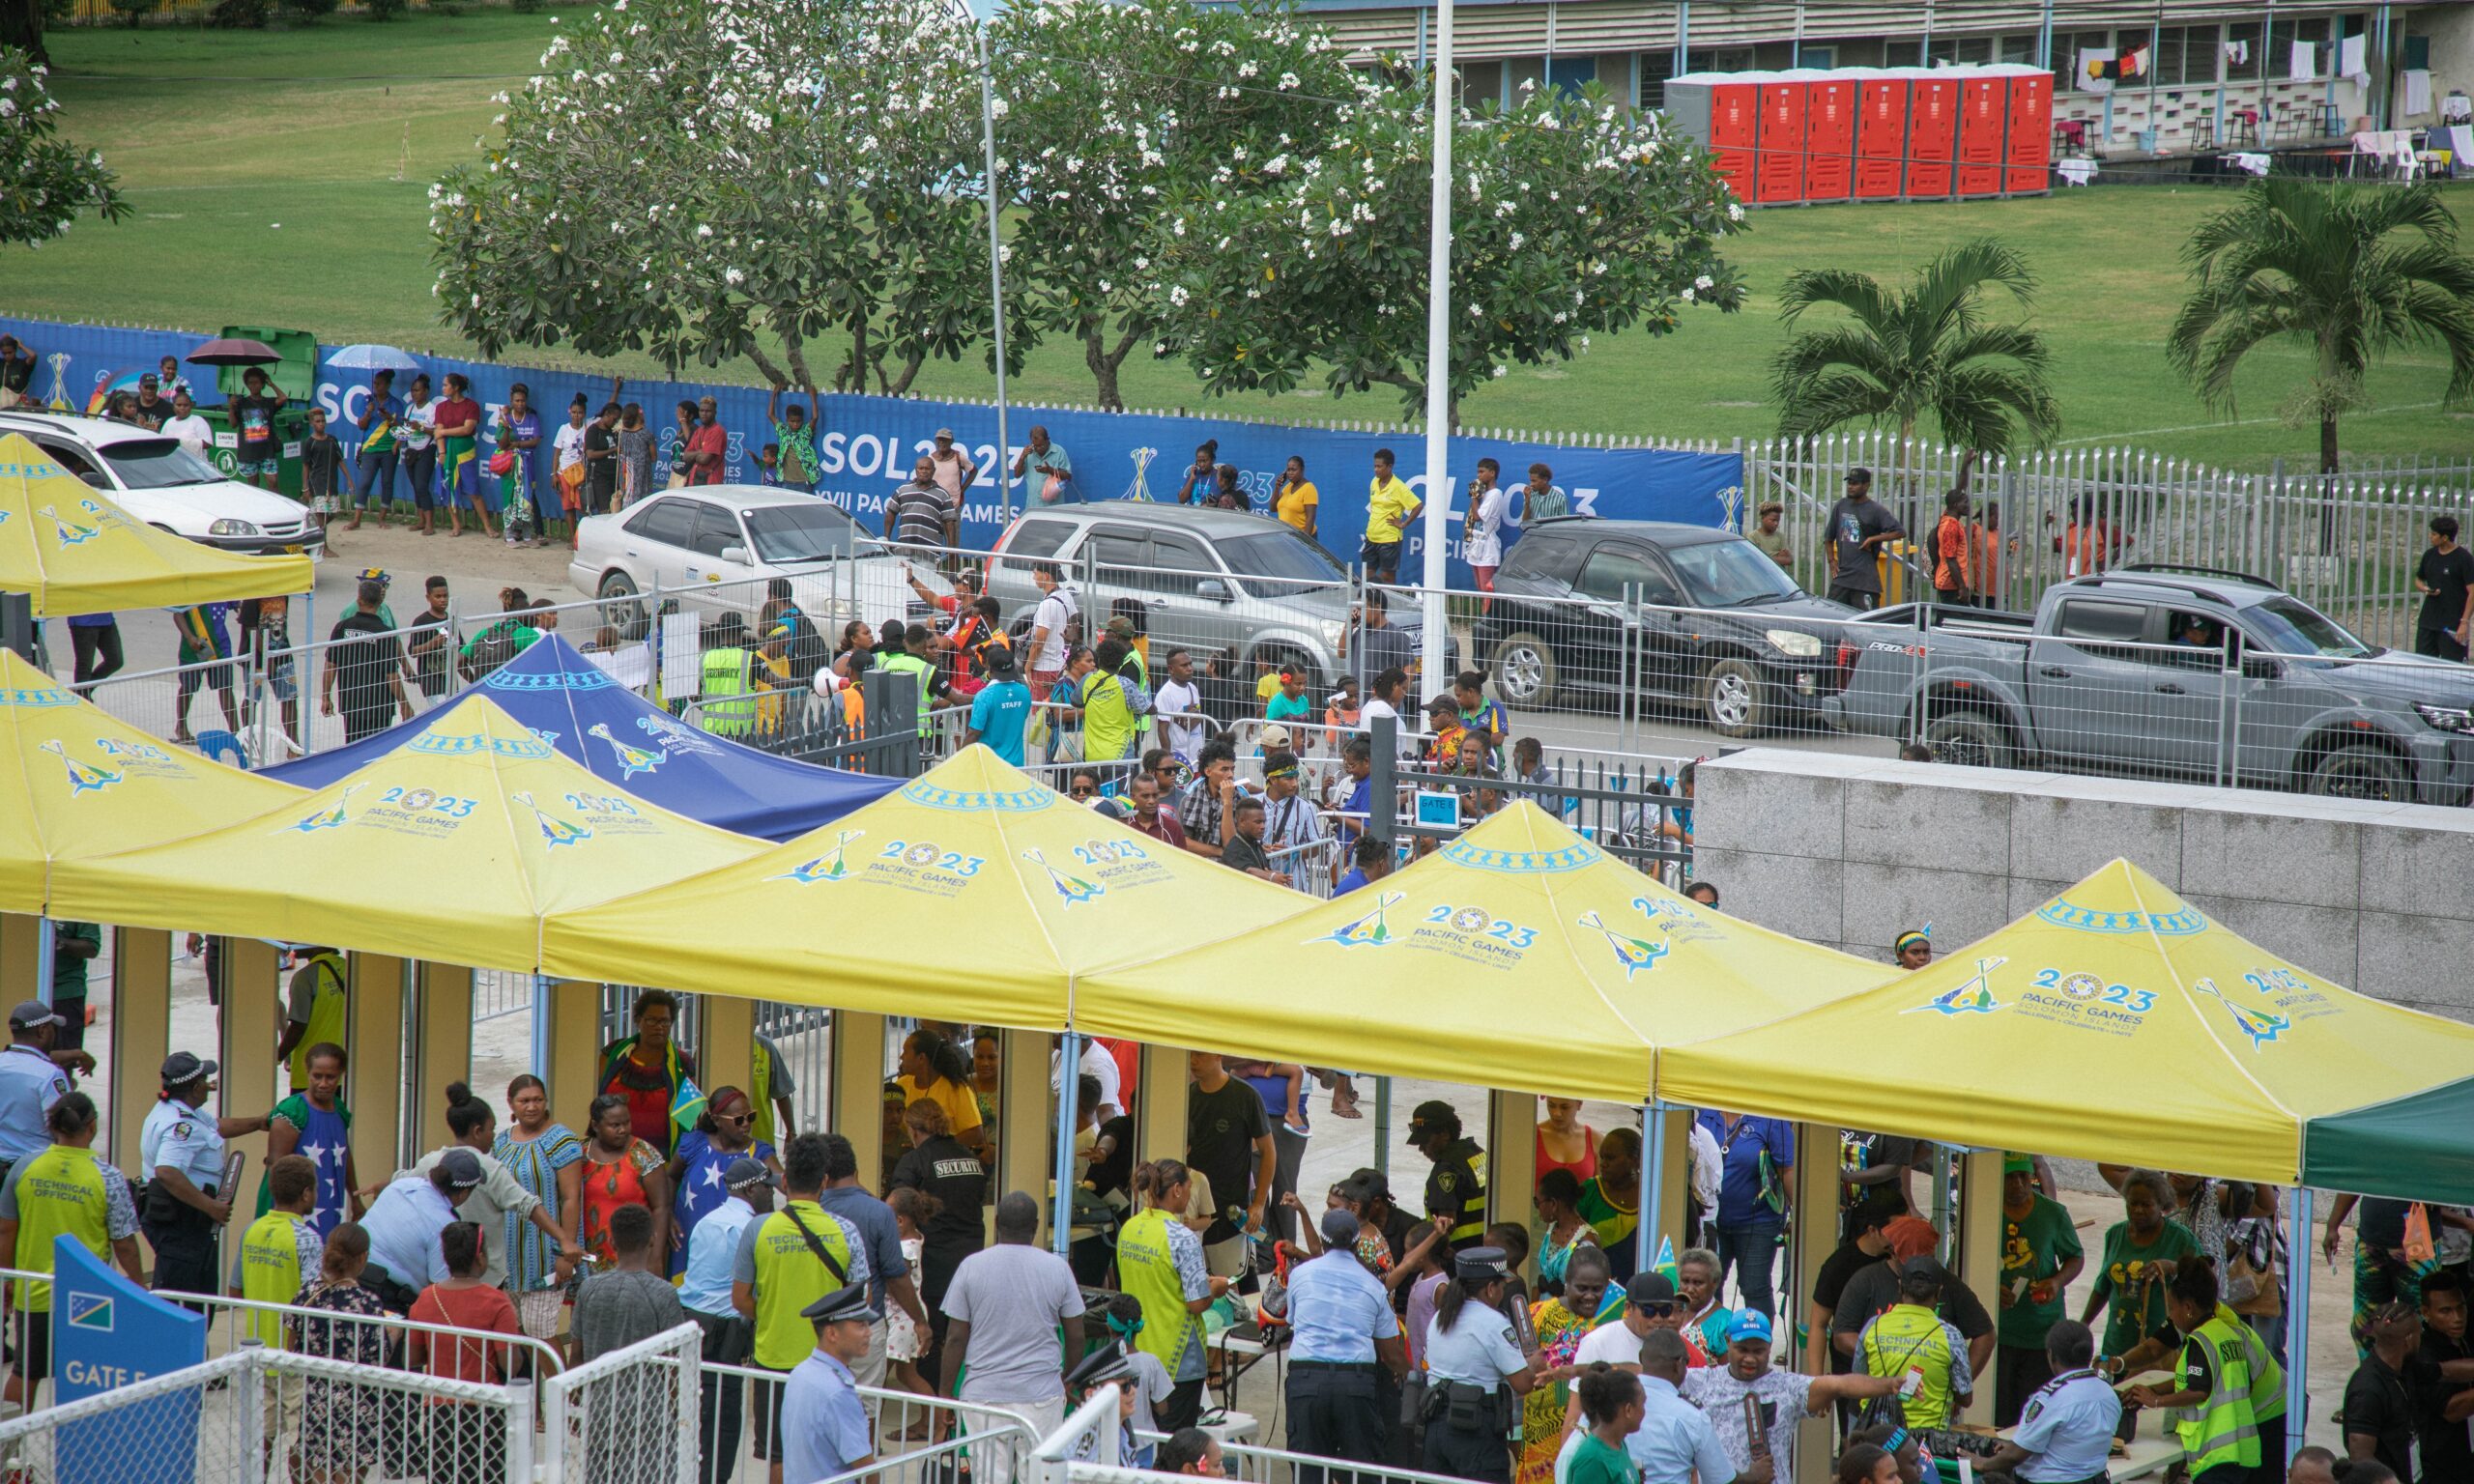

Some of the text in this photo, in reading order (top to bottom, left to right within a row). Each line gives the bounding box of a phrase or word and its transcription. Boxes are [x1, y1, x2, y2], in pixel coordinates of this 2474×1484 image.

[820, 432, 1023, 488] SOL223
[961, 502, 1021, 523] AMES
[705, 668, 740, 678] SECURITY
[1001, 700, 1022, 709] STAFF
[379, 786, 479, 817] 2023
[1422, 798, 1446, 810] GATE
[364, 808, 462, 829] PACIFIC GAMES
[880, 841, 986, 877] 2023
[868, 863, 969, 888] PACIFIC GAMES
[1425, 905, 1539, 949] 2023
[1414, 928, 1523, 960] PACIFIC GAMES
[2031, 968, 2159, 1013] 2023
[2017, 1002, 2138, 1032] SOLOMON ISLANDS
[2021, 992, 2143, 1025] PACIFIC GAMES
[935, 1160, 982, 1176] SECURITY
[30, 1178, 94, 1197] TECHNICAL
[34, 1188, 85, 1205] OFFICIAL
[766, 1235, 836, 1245] TECHNAL
[774, 1244, 810, 1254] OFFIC
[66, 1359, 128, 1388] GATE
